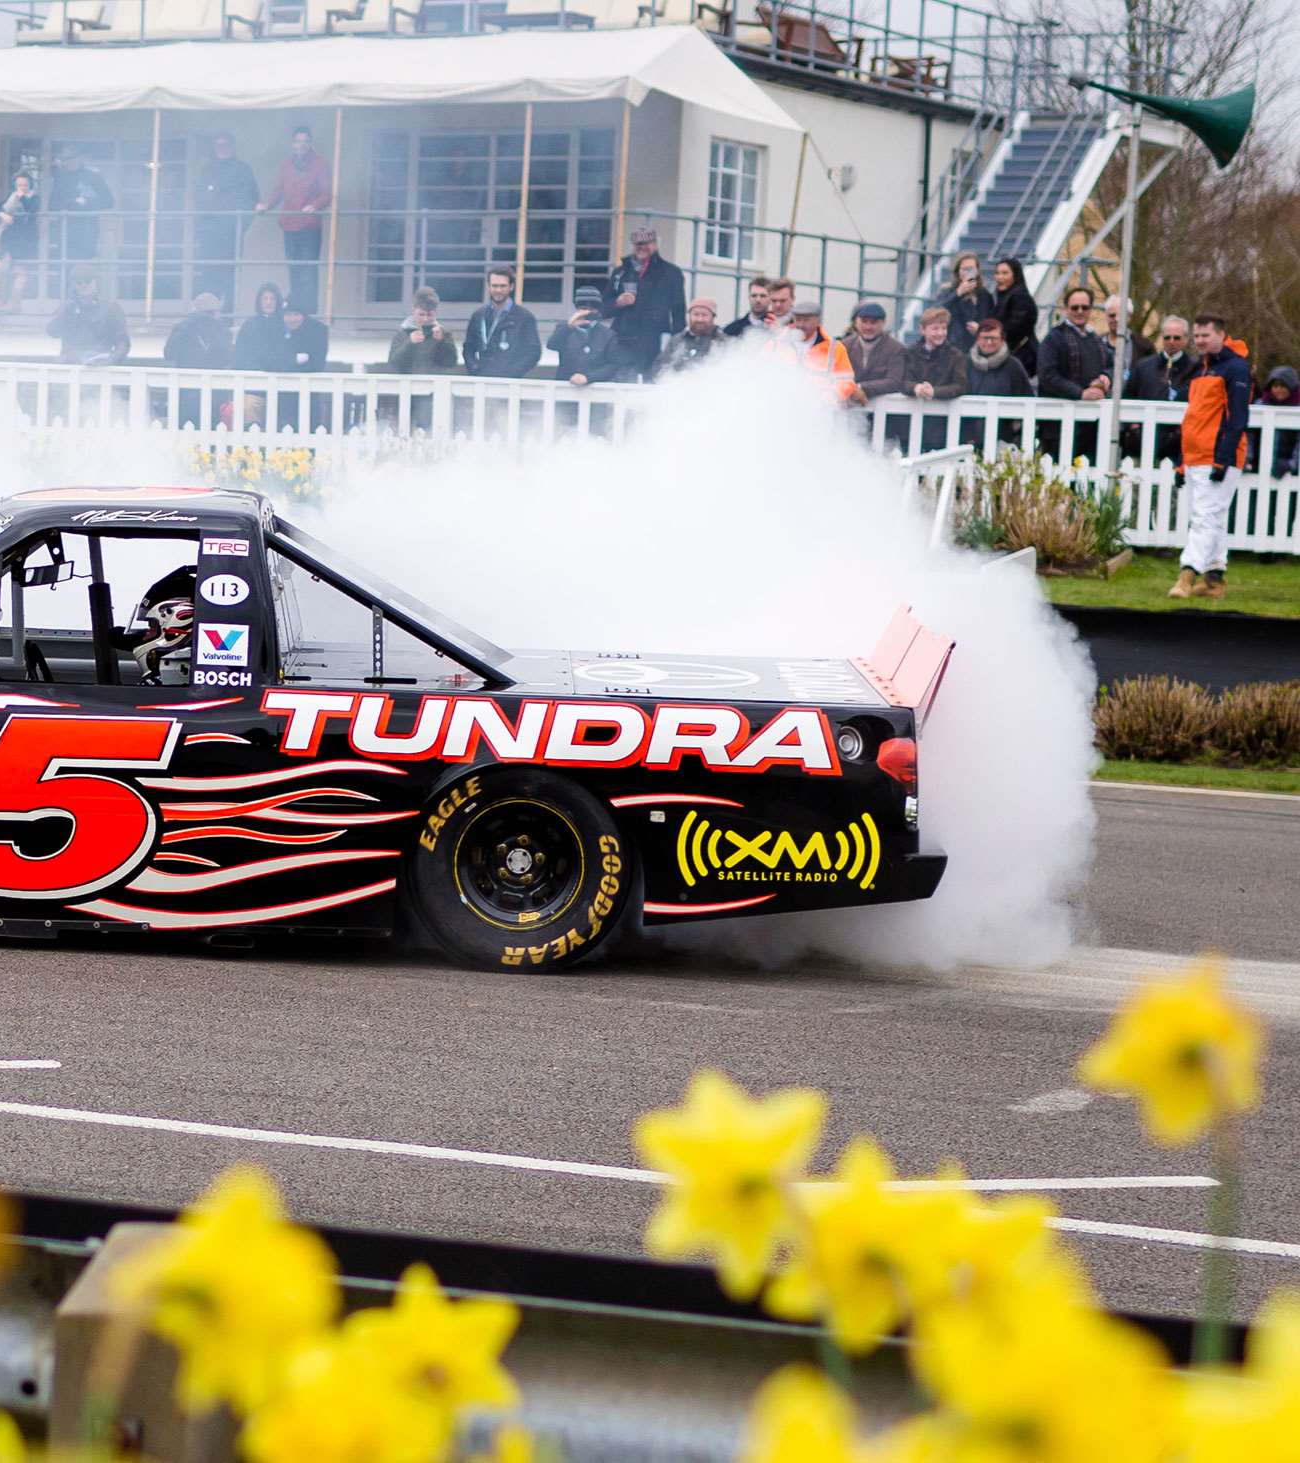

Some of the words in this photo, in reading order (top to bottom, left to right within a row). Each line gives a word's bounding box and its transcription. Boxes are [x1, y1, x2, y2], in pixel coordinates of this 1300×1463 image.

[204, 541, 248, 554] TRD
[210, 582, 240, 597] 113
[203, 652, 243, 661] Valvoline
[194, 670, 253, 687] BOSCH
[262, 690, 842, 777] TUNDRA
[419, 775, 484, 852] EAGLE
[724, 830, 833, 870] XM
[500, 834, 623, 966] GOODYEAR
